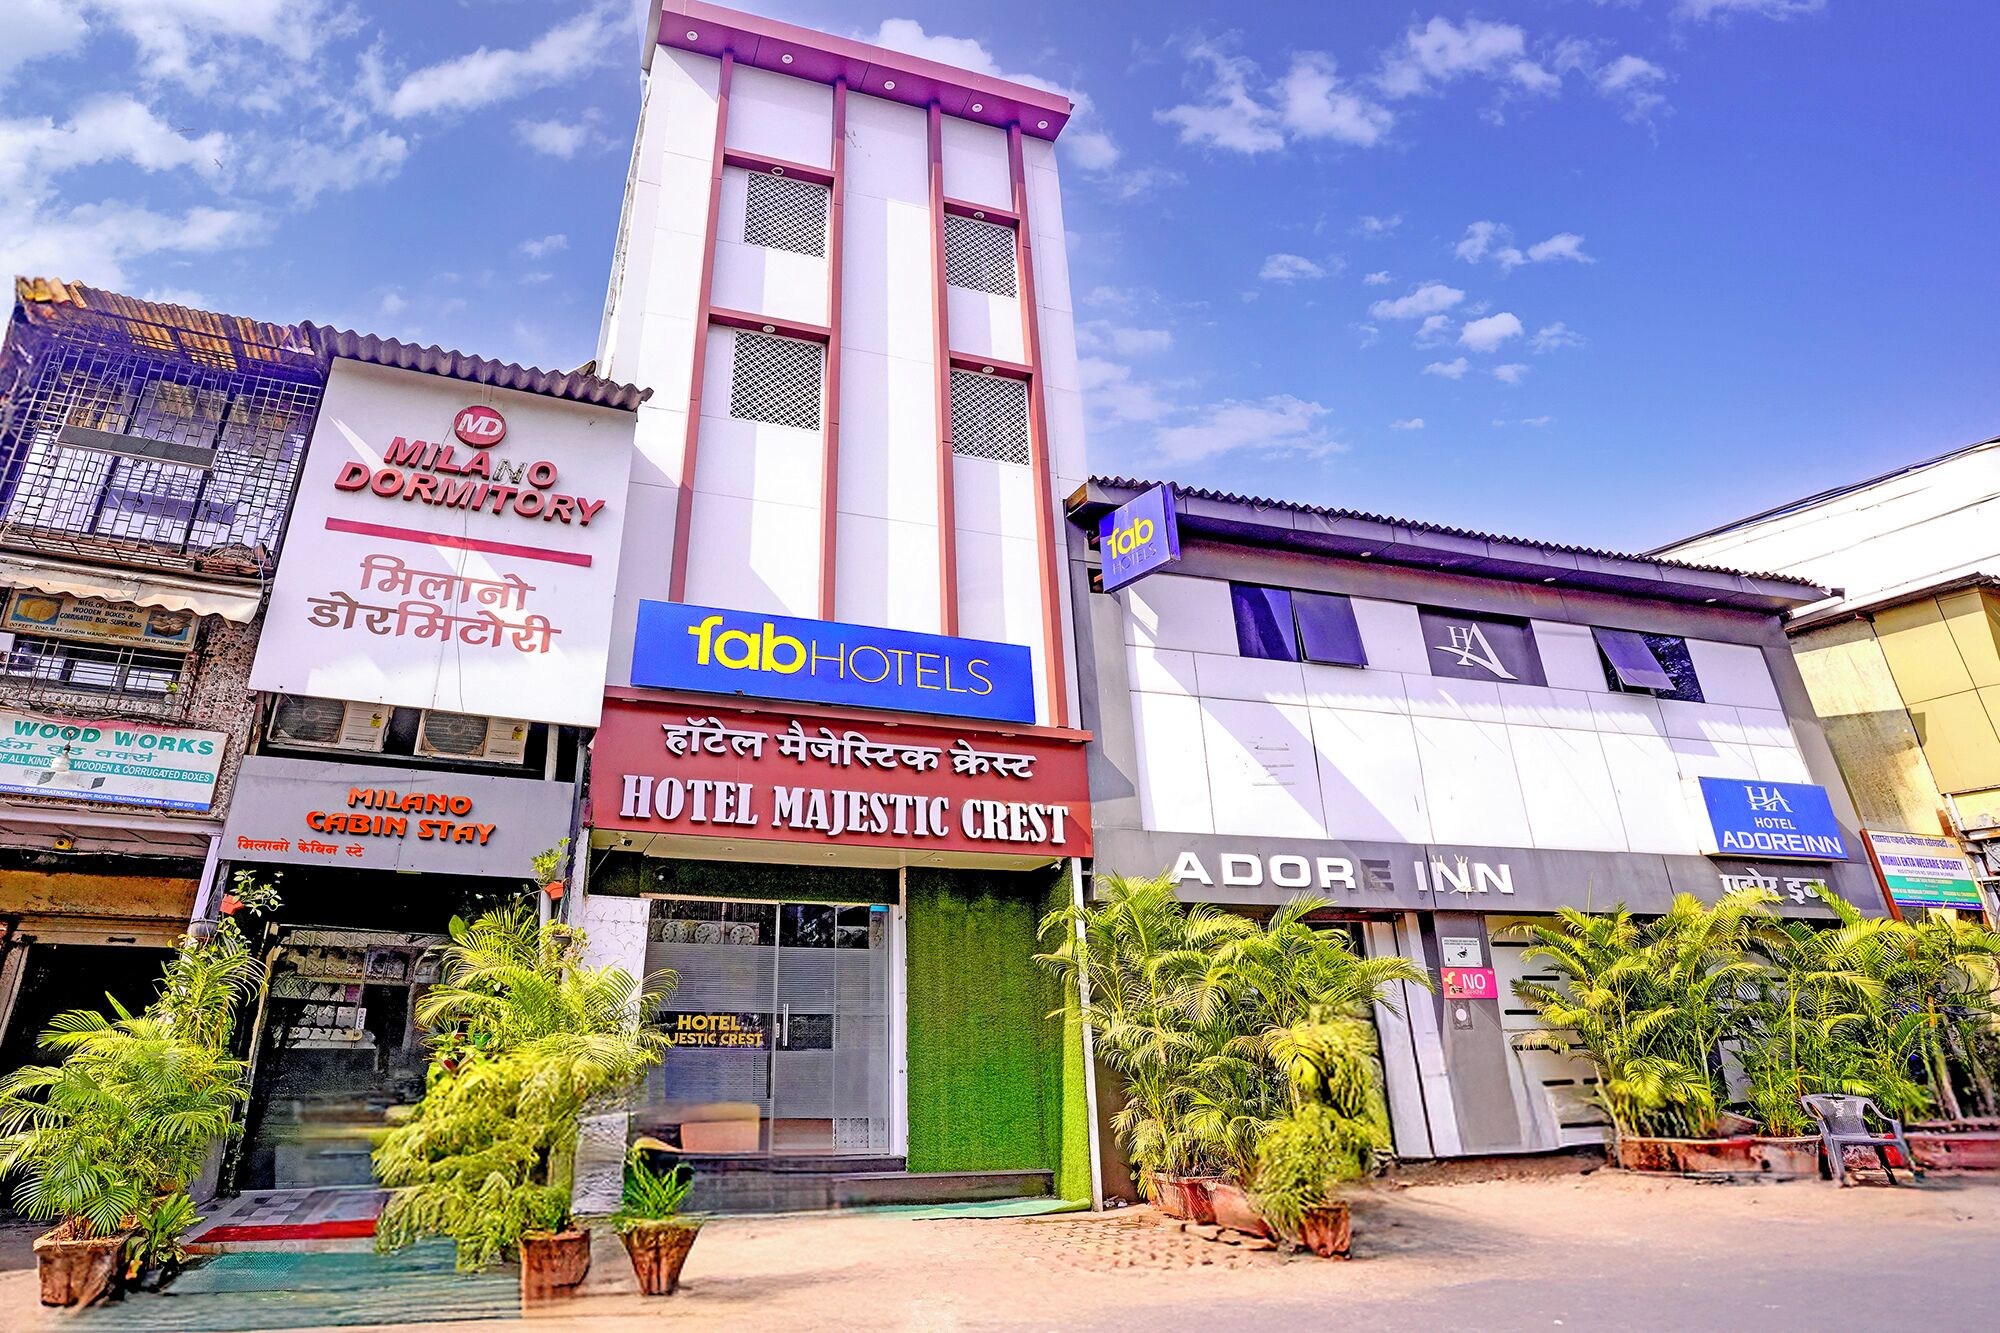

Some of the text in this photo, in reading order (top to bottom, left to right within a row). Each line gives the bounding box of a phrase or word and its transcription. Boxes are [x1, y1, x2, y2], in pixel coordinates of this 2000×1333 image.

[455, 411, 503, 439] MD
[383, 436, 558, 490] MILANO
[334, 461, 606, 526] DORMITORY
[1107, 517, 1154, 560] fab
[1112, 542, 1157, 576] HOTELS
[360, 554, 537, 612] मिलानो
[60, 612, 142, 629] CORRUGATED BOX SUPPLIERS
[73, 607, 101, 616] WOODEN
[105, 611, 126, 619] BOXES
[307, 591, 562, 653] डोरमिटोरी
[14, 720, 214, 756] WOOD WORKS
[662, 717, 1037, 778] हॉटेल मैजेस्टिक क्रेस्ट
[8, 754, 26, 764] ALL
[74, 760, 112, 773] WOODEN
[113, 764, 121, 773] &
[122, 765, 180, 779] CORRUGATED
[181, 771, 210, 783] BOXES
[347, 787, 472, 815] MILANO
[619, 774, 1069, 844] HOTEL MAJESTIC CREST
[305, 810, 497, 846] CABIN STAY
[1754, 816, 1797, 830] HOTEL
[237, 836, 365, 858] मिलानो केबिन स्टे
[1723, 830, 1843, 854] ADOREINN
[1413, 860, 1515, 895] INN
[1901, 857, 1916, 868] EKTA
[1914, 859, 1940, 870] WELFARE
[1940, 861, 1964, 871] SOCIETY
[1462, 974, 1486, 989] NO
[677, 1014, 741, 1031] HOTEL
[719, 1034, 763, 1047] CREST
